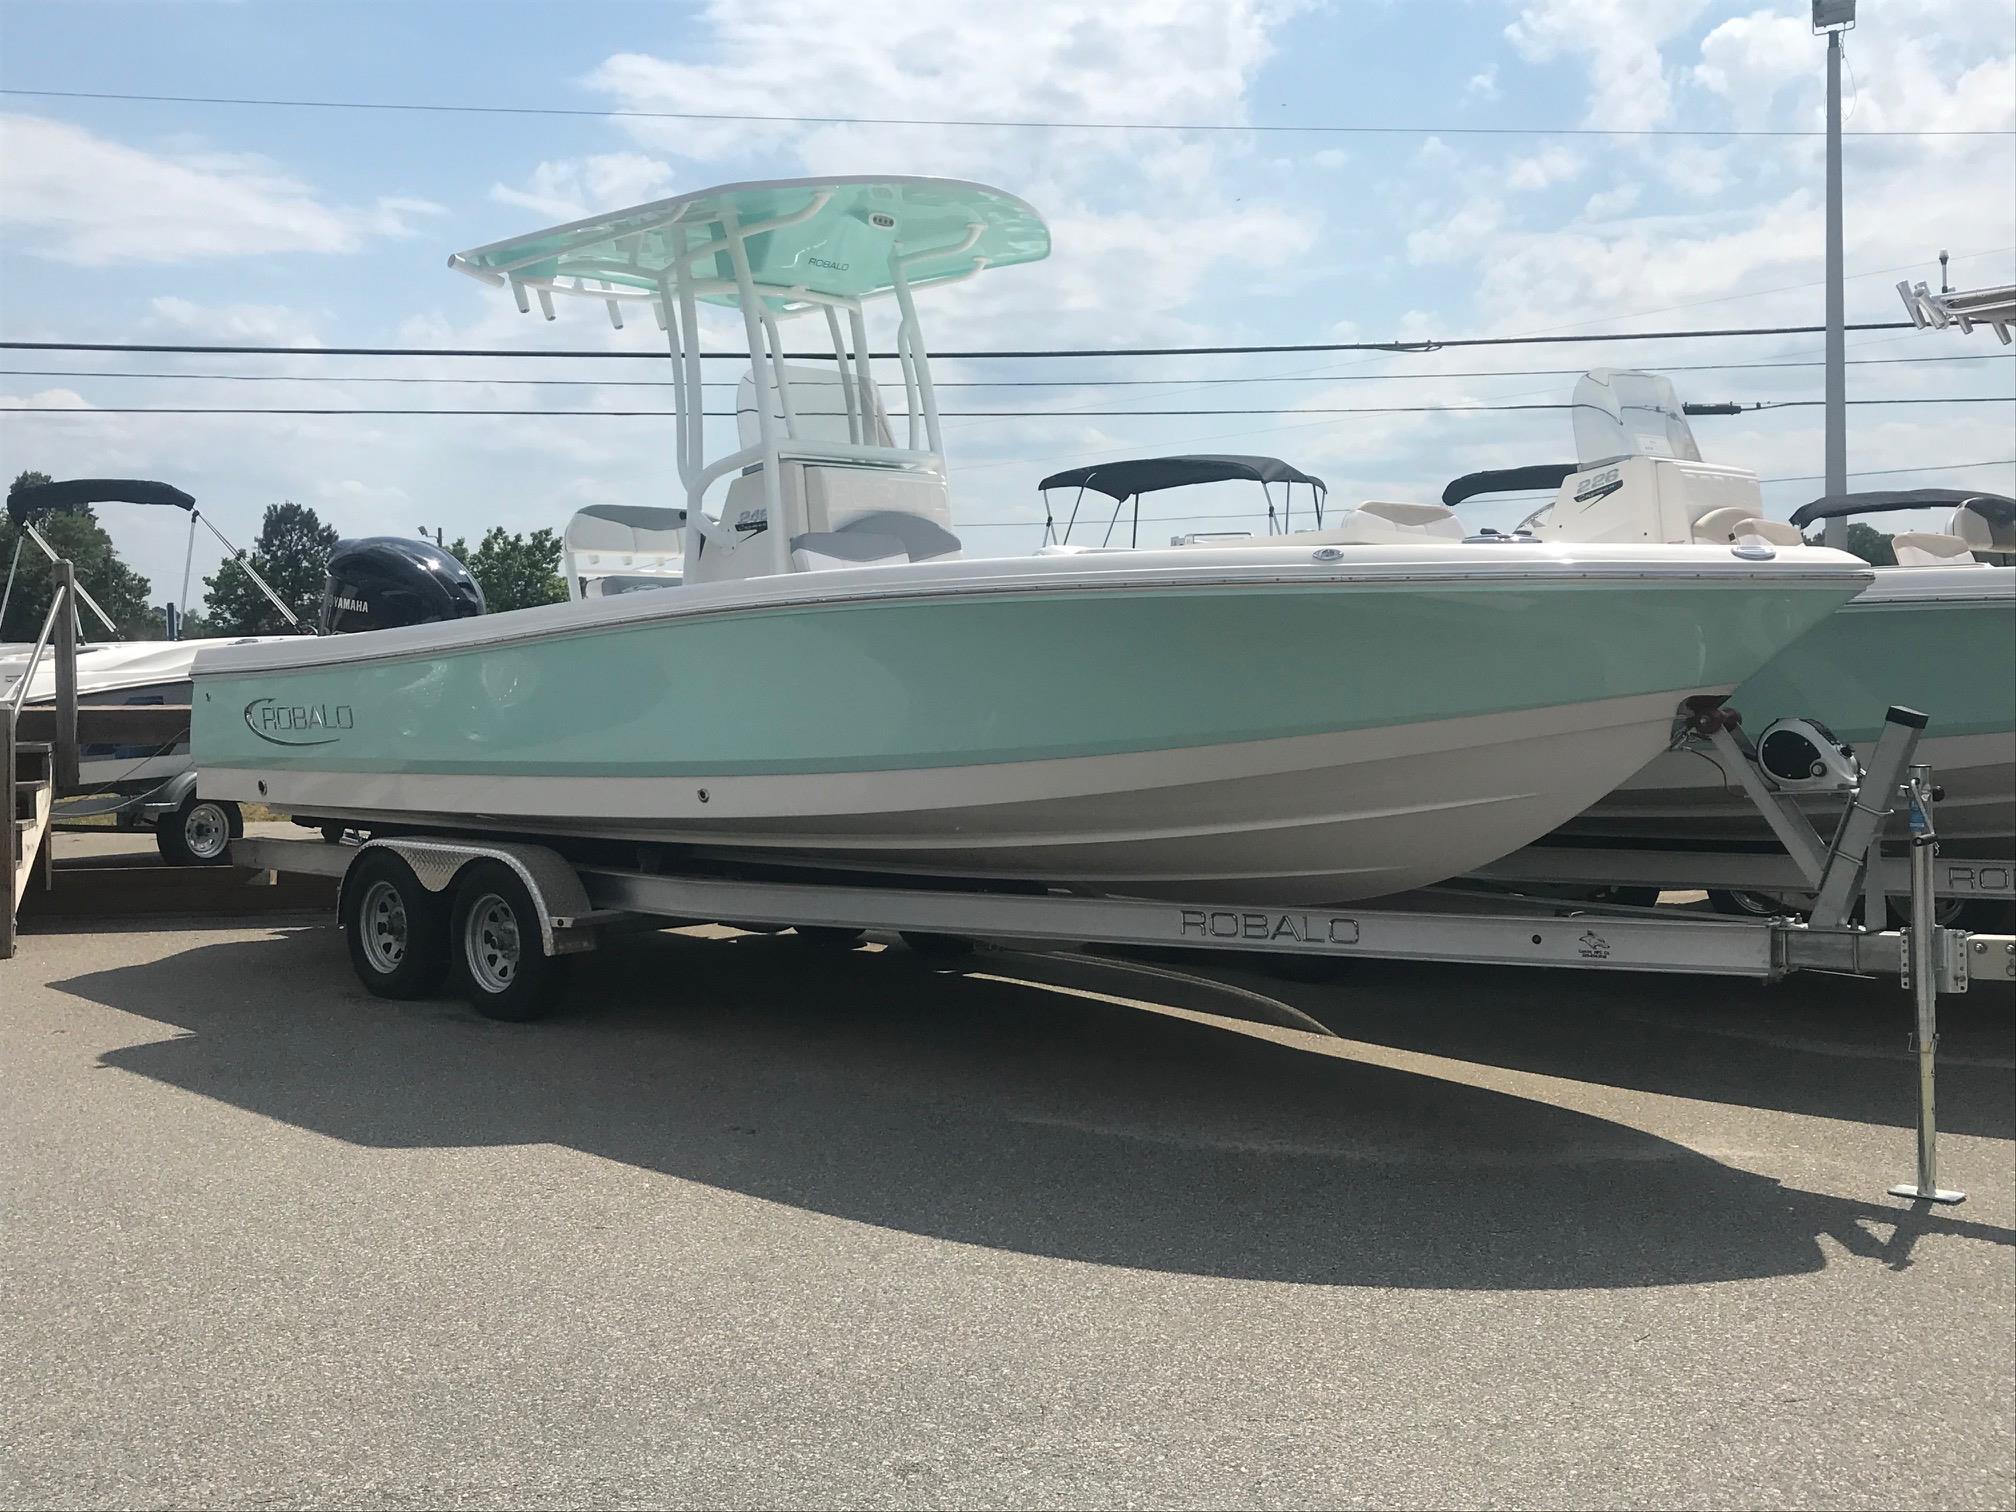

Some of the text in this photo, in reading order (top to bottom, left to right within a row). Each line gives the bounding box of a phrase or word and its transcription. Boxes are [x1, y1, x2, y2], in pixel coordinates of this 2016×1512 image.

[808, 257, 850, 272] ROBALO
[1577, 468, 1620, 495] 226
[334, 596, 369, 613] YAMAHA
[261, 703, 354, 731] ROBALO
[1948, 867, 2016, 890] RO
[1180, 910, 1360, 945] ROBALO
